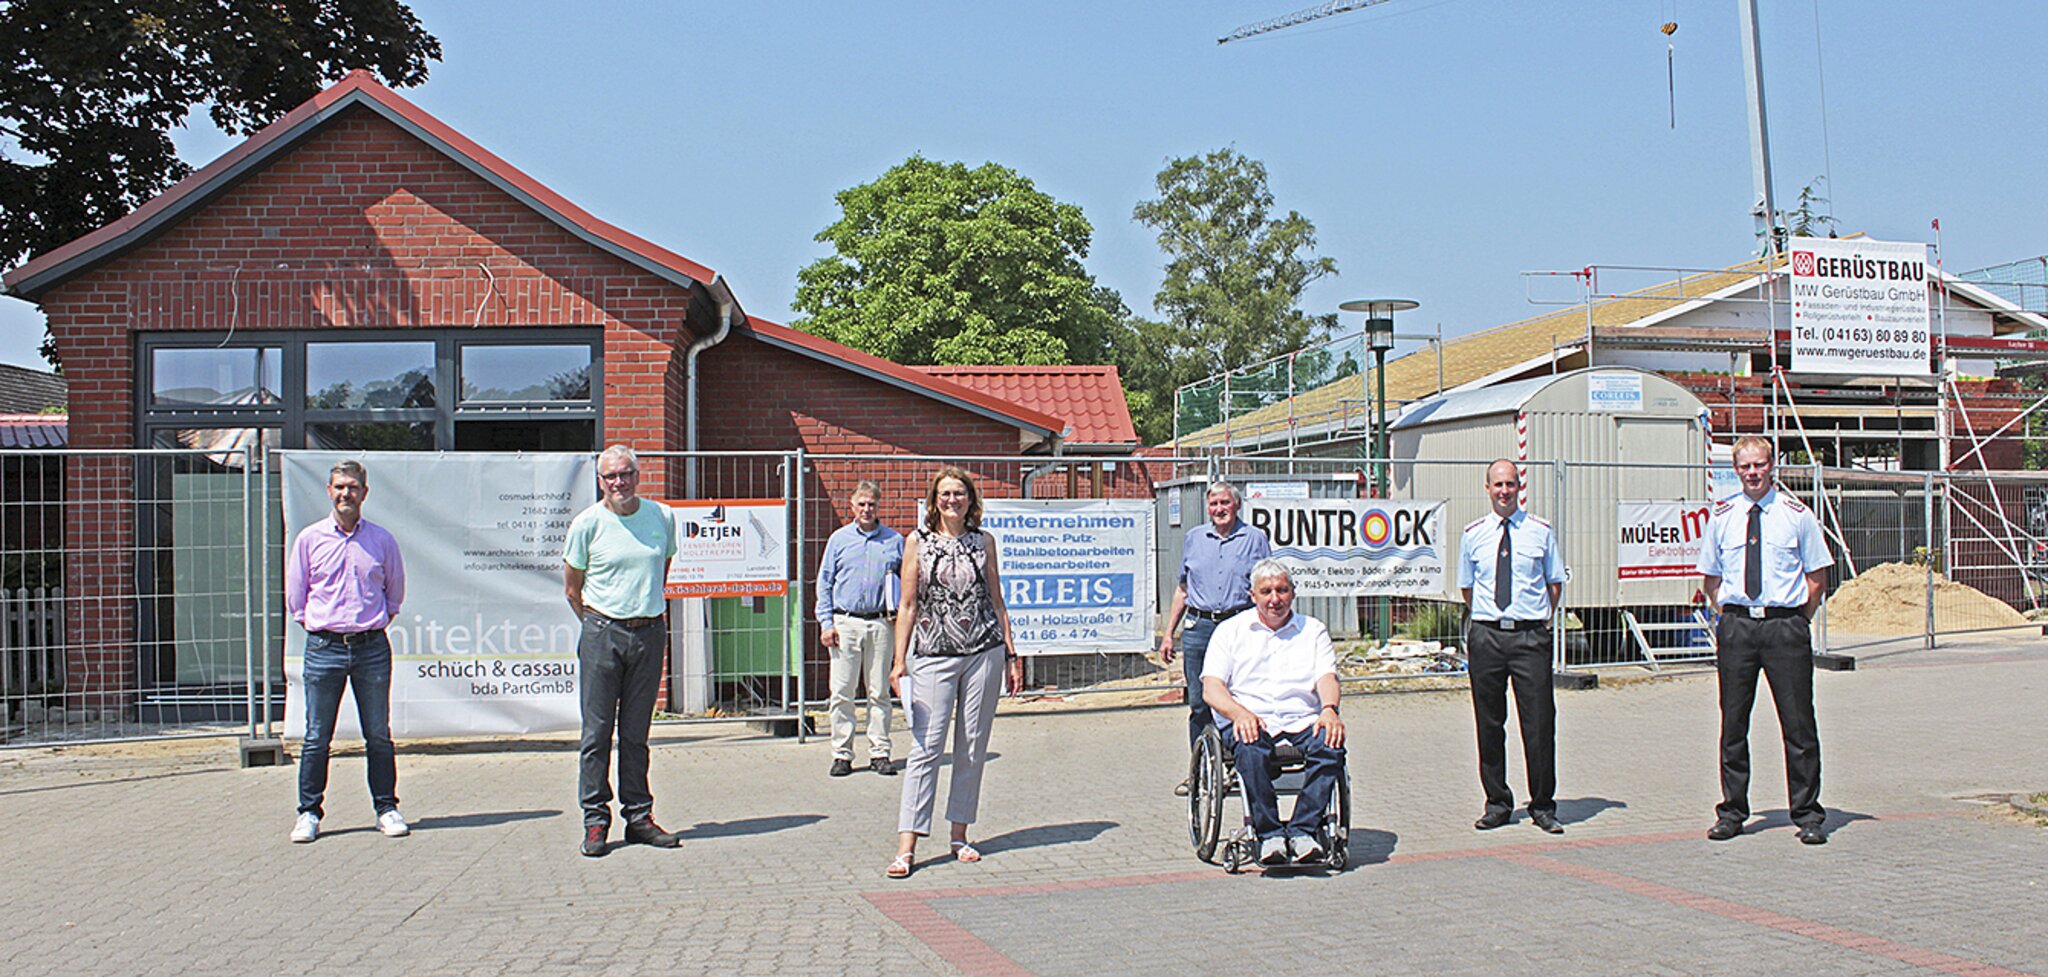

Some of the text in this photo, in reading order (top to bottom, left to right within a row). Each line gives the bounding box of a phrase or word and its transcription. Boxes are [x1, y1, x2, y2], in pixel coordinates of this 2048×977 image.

[1817, 254, 1924, 281] GERÜSTBAU
[1795, 284, 1925, 302] MW Gerüstbau GmbH
[1796, 326, 1818, 340] Tel.
[1876, 329, 1891, 342] 80
[1893, 330, 1908, 343] 89
[1911, 331, 1926, 343] 80
[1796, 347, 1927, 360] www.mwgeruestbau.de
[566, 492, 572, 500] 2
[549, 506, 572, 515] stade
[1252, 508, 1433, 548] BUNTROCK
[1621, 521, 1680, 544] MÜLLER
[522, 534, 534, 543] fax
[1002, 533, 1096, 544] Maurer- Putz-
[1002, 545, 1135, 558] Stahlbetonarbeiten
[464, 562, 564, 571] info@architekten-stade.
[1002, 560, 1110, 570] Fliesenarbeiten
[1291, 566, 1319, 575] Sanitär
[1328, 566, 1355, 575] Elektro
[1393, 565, 1412, 575] Solar
[1420, 565, 1441, 574] Klima
[1000, 577, 1114, 605] RLEIS
[1041, 613, 1113, 625] Holzstraße
[1118, 612, 1133, 623] 17
[1020, 630, 1036, 640] 41
[1041, 630, 1057, 640] 66
[1069, 629, 1078, 639] 4
[1082, 629, 1098, 639] 74
[418, 660, 575, 678] schüch & cassau
[471, 681, 575, 695] bda PartGmbB
